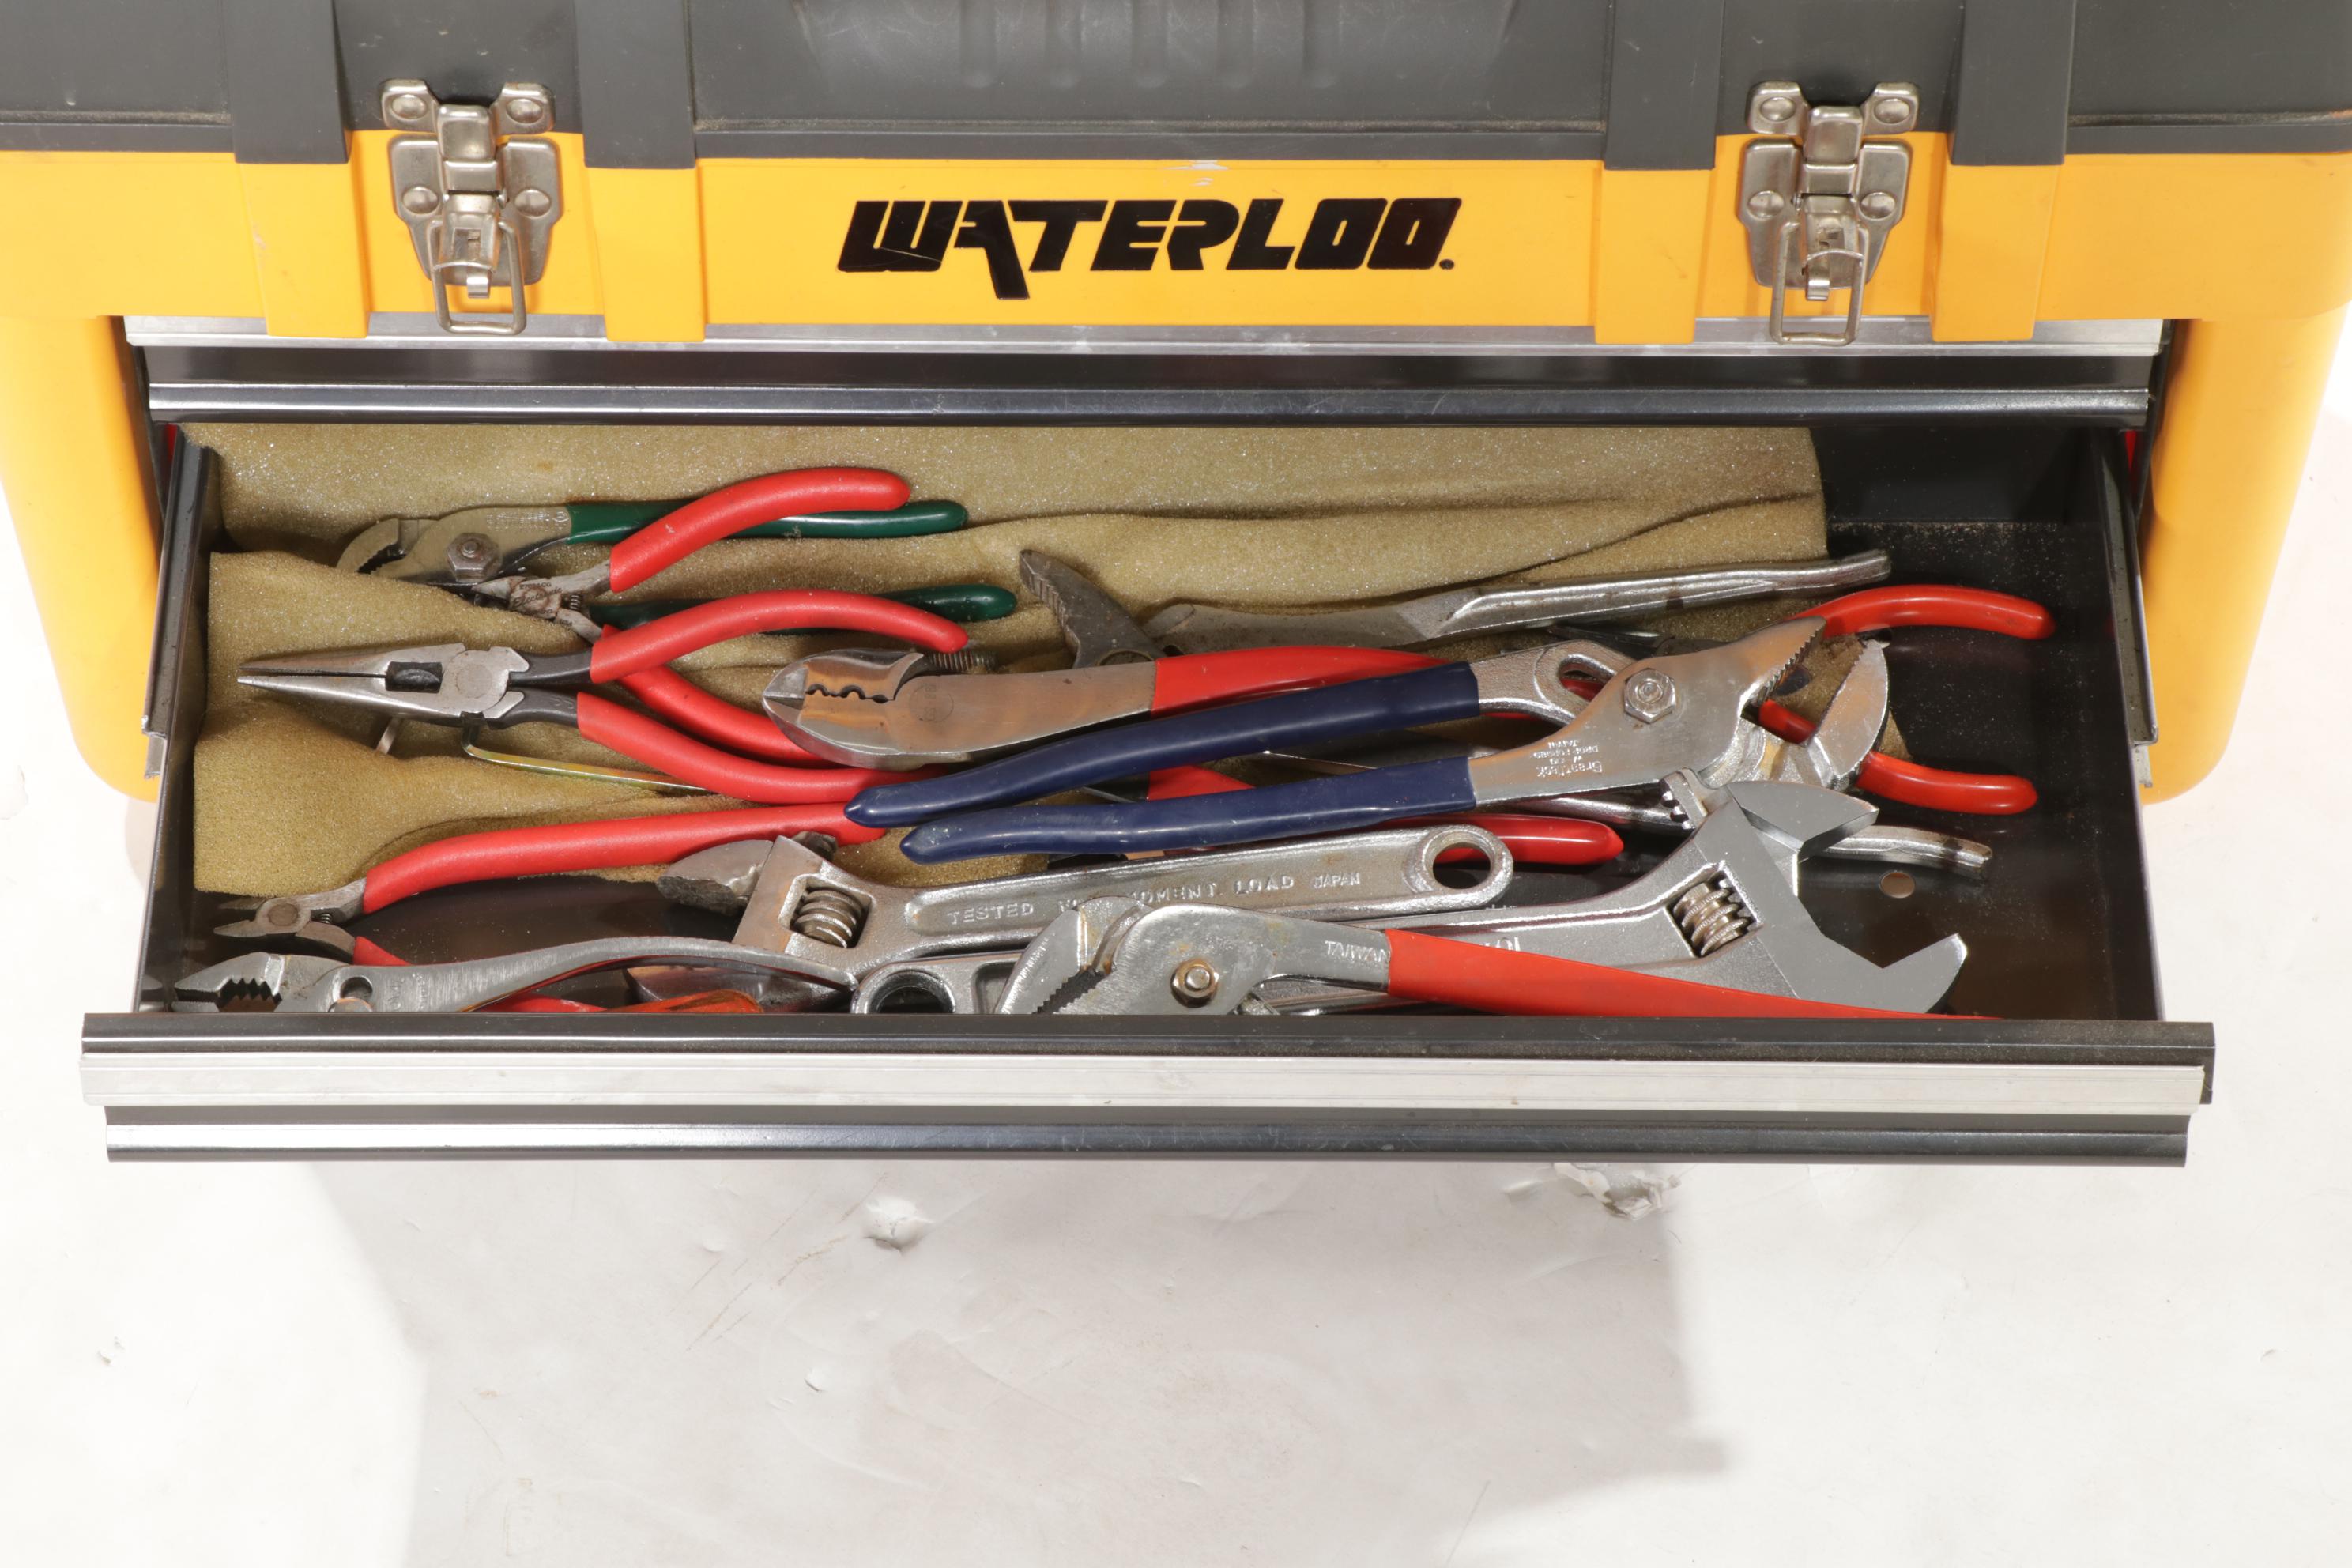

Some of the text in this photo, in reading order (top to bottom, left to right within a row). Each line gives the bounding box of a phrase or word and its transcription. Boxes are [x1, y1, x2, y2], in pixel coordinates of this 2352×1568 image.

[948, 903, 1034, 925] TESTED
[1233, 875, 1295, 895] LOAD
[1313, 872, 1361, 889] JAPAN
[1324, 940, 1391, 963] TAIWAN
